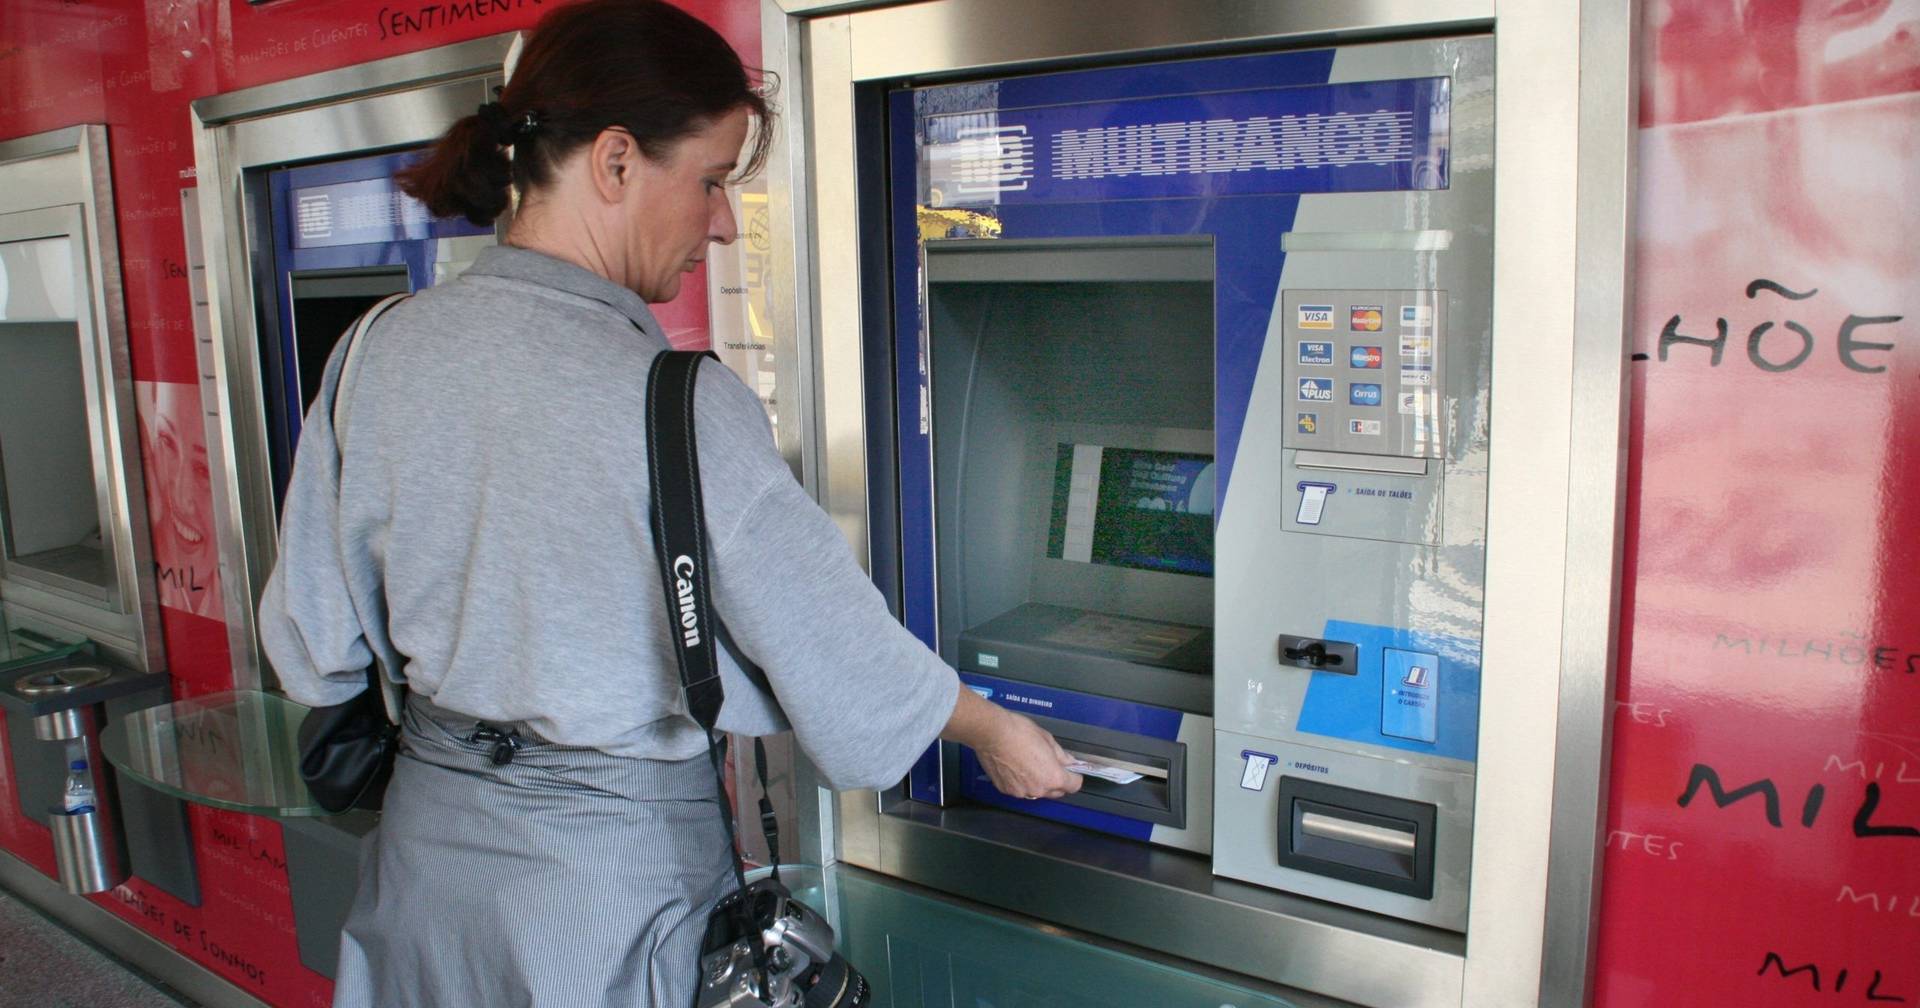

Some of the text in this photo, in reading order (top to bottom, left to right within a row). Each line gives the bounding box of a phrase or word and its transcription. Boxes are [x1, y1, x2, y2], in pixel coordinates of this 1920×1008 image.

[1052, 109, 1413, 180] MULTIBANCO
[1304, 311, 1328, 322] VISA
[1631, 278, 1904, 374] HÕE
[1307, 344, 1324, 352] VISA
[1301, 356, 1331, 364] Electron
[1352, 353, 1380, 363] Maestro
[1308, 389, 1331, 400] PLUS
[1353, 388, 1377, 399] Cirrus
[1356, 487, 1412, 499] SAÍDA DE TALÕES
[156, 562, 204, 592] MIL
[673, 554, 701, 648] Canon
[1712, 631, 1920, 674] MILHÕES
[1021, 696, 1029, 704] DE
[1295, 761, 1329, 774] DEPÓSITOS
[1824, 754, 1920, 783] MIL
[1677, 763, 1920, 838] MIL
[173, 919, 193, 943] DE
[1757, 952, 1906, 1003] MIL
